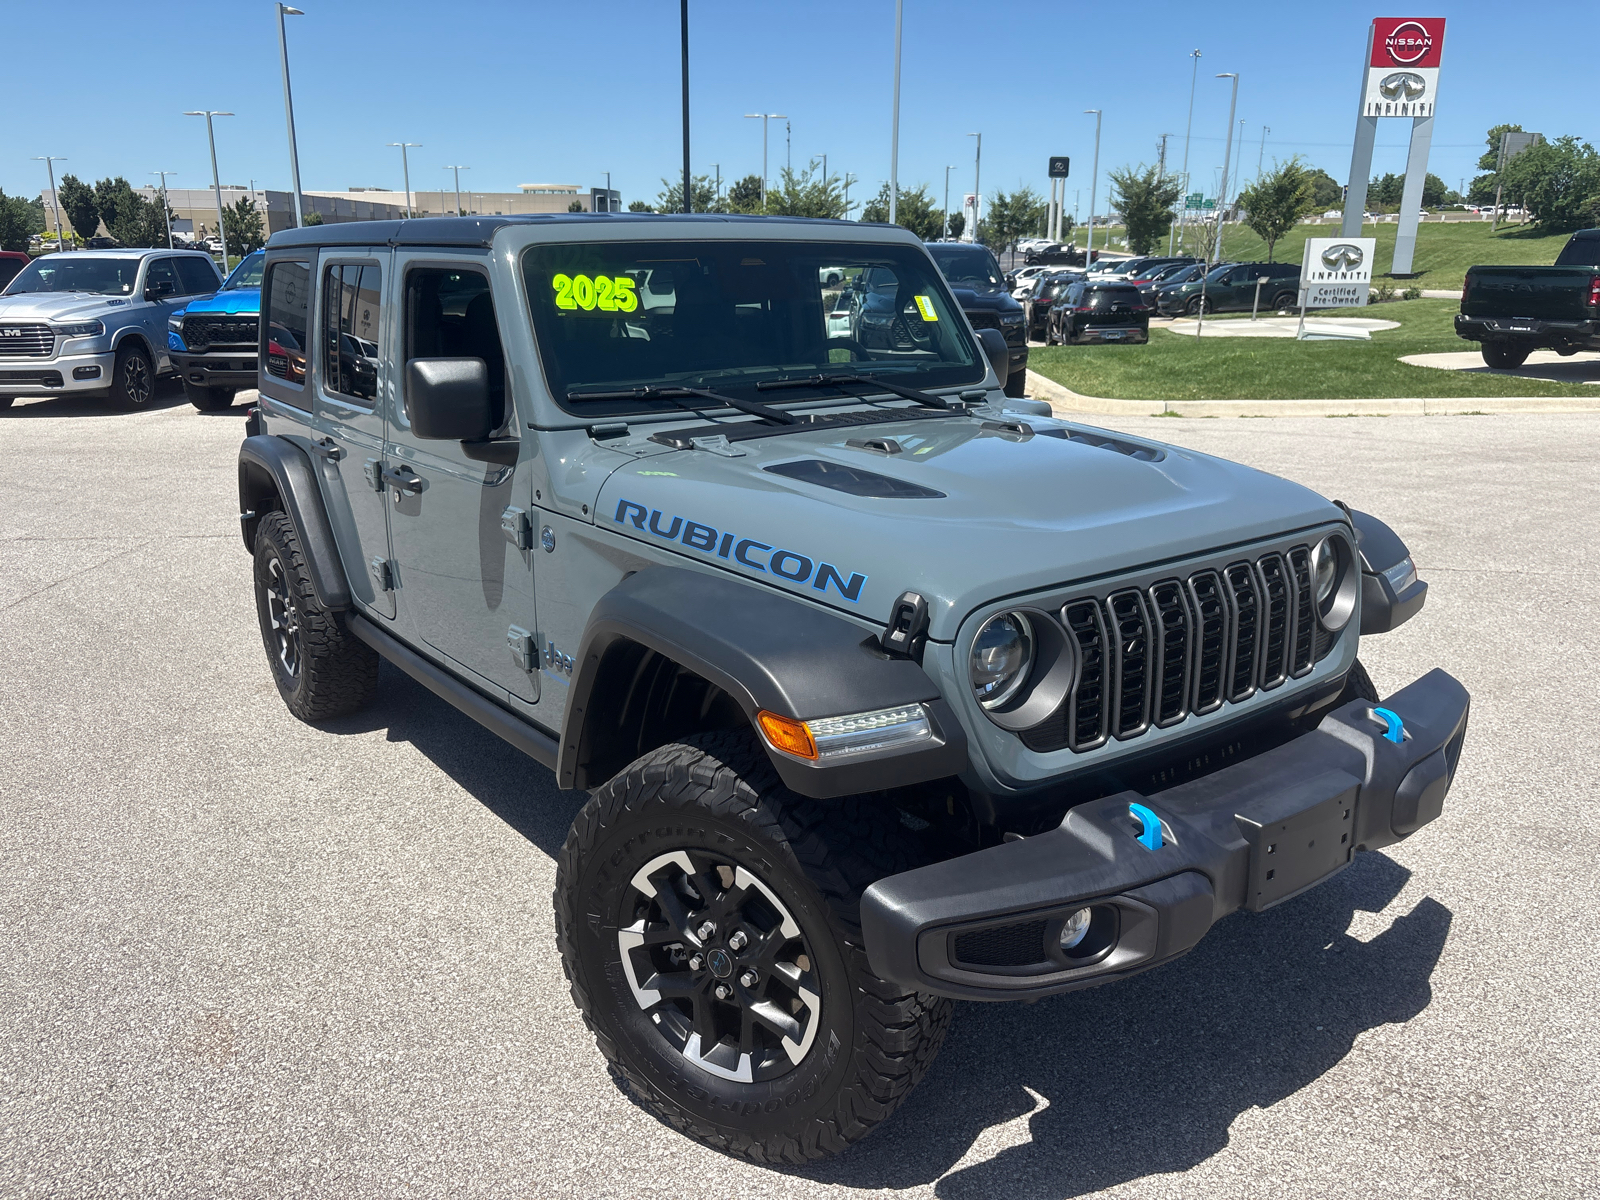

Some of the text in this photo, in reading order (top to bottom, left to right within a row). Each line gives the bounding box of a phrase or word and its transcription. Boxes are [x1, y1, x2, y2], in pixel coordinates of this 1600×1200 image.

[1385, 38, 1432, 46] NISSAN
[1367, 103, 1432, 116] INFINITI
[1312, 272, 1367, 280] INFINITI
[553, 274, 638, 313] 2025
[1319, 288, 1357, 296] Certified
[1313, 296, 1360, 304] Pre-Owned
[614, 498, 868, 603] RUBICON
[543, 640, 576, 677] Jee
